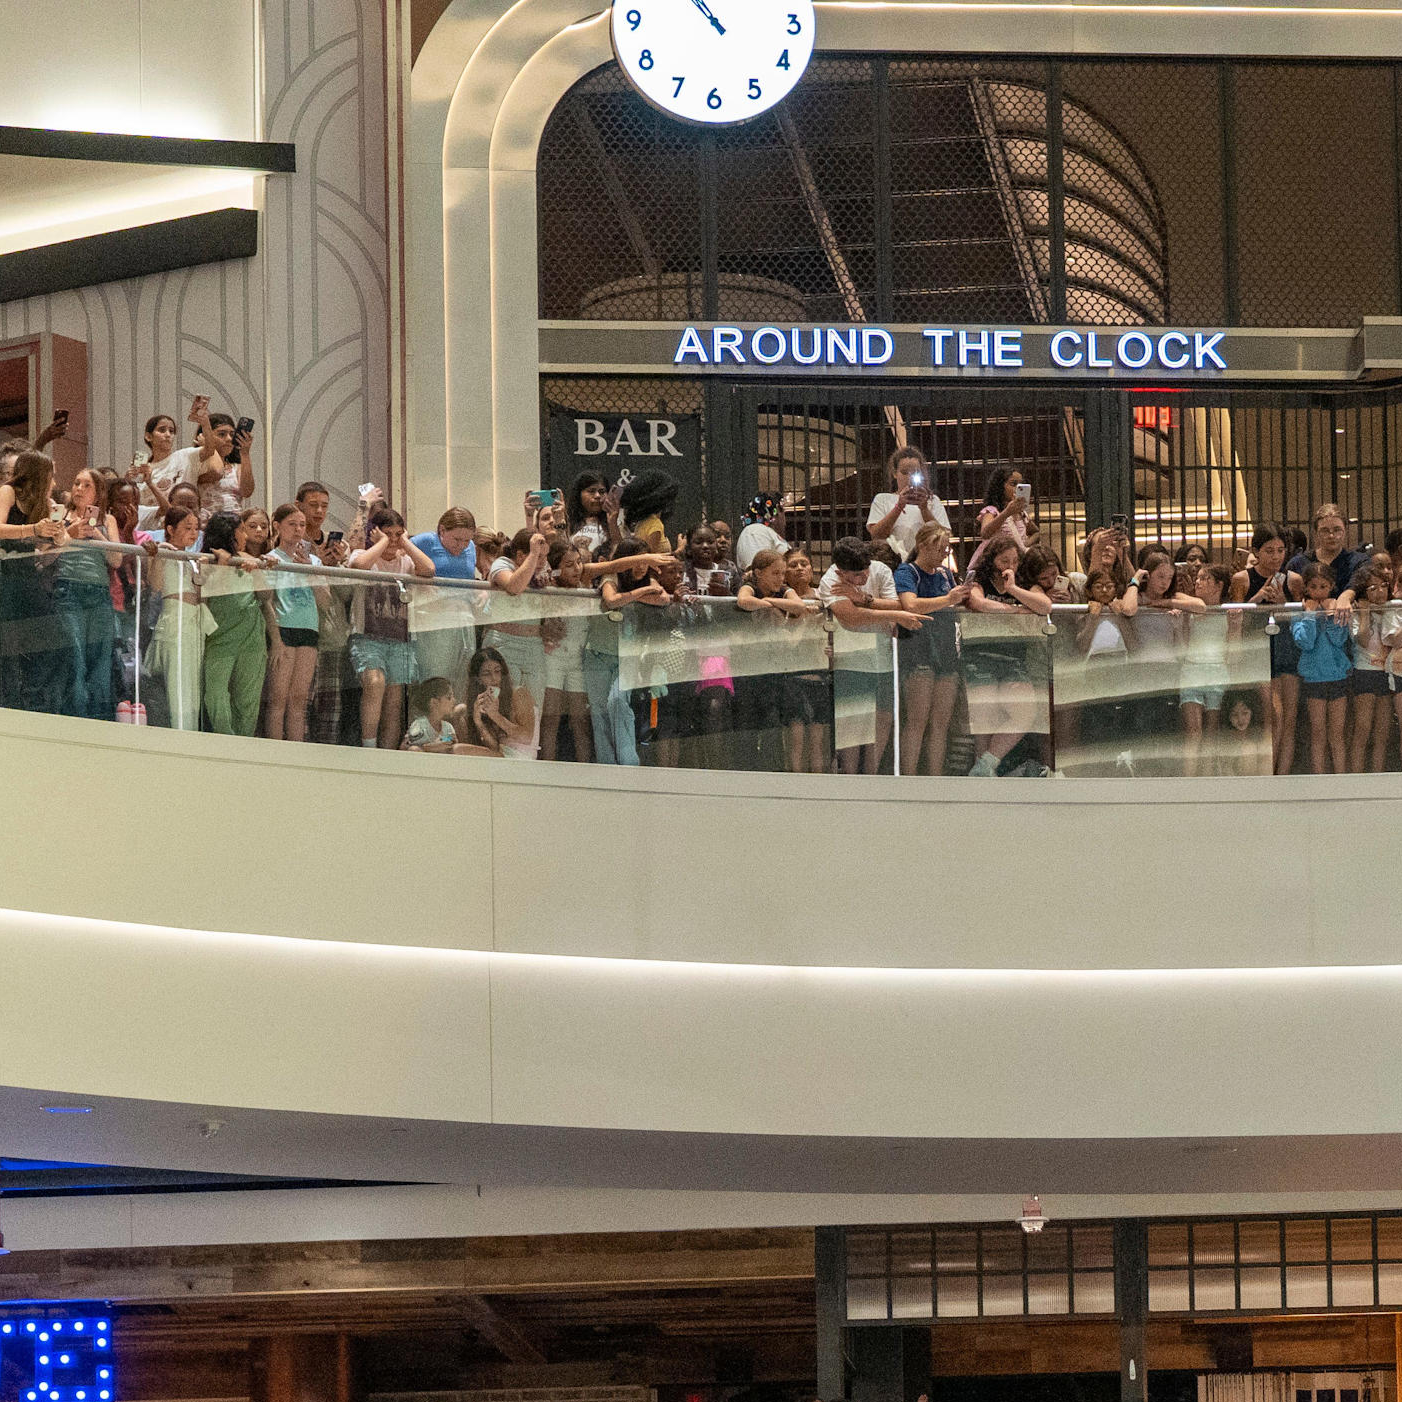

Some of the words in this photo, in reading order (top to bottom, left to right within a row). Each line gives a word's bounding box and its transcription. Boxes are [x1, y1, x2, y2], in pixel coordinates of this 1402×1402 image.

[626, 9, 641, 31] 9
[787, 13, 802, 35] 3
[638, 48, 654, 71] 8
[776, 48, 790, 71] 4
[672, 76, 685, 98] 7
[747, 78, 762, 100] 5
[706, 87, 722, 110] 6
[673, 327, 895, 365] AROUND
[922, 329, 1024, 367] THE
[1049, 330, 1228, 369] CLOCK
[573, 418, 684, 457] BAR
[617, 468, 637, 488] &
